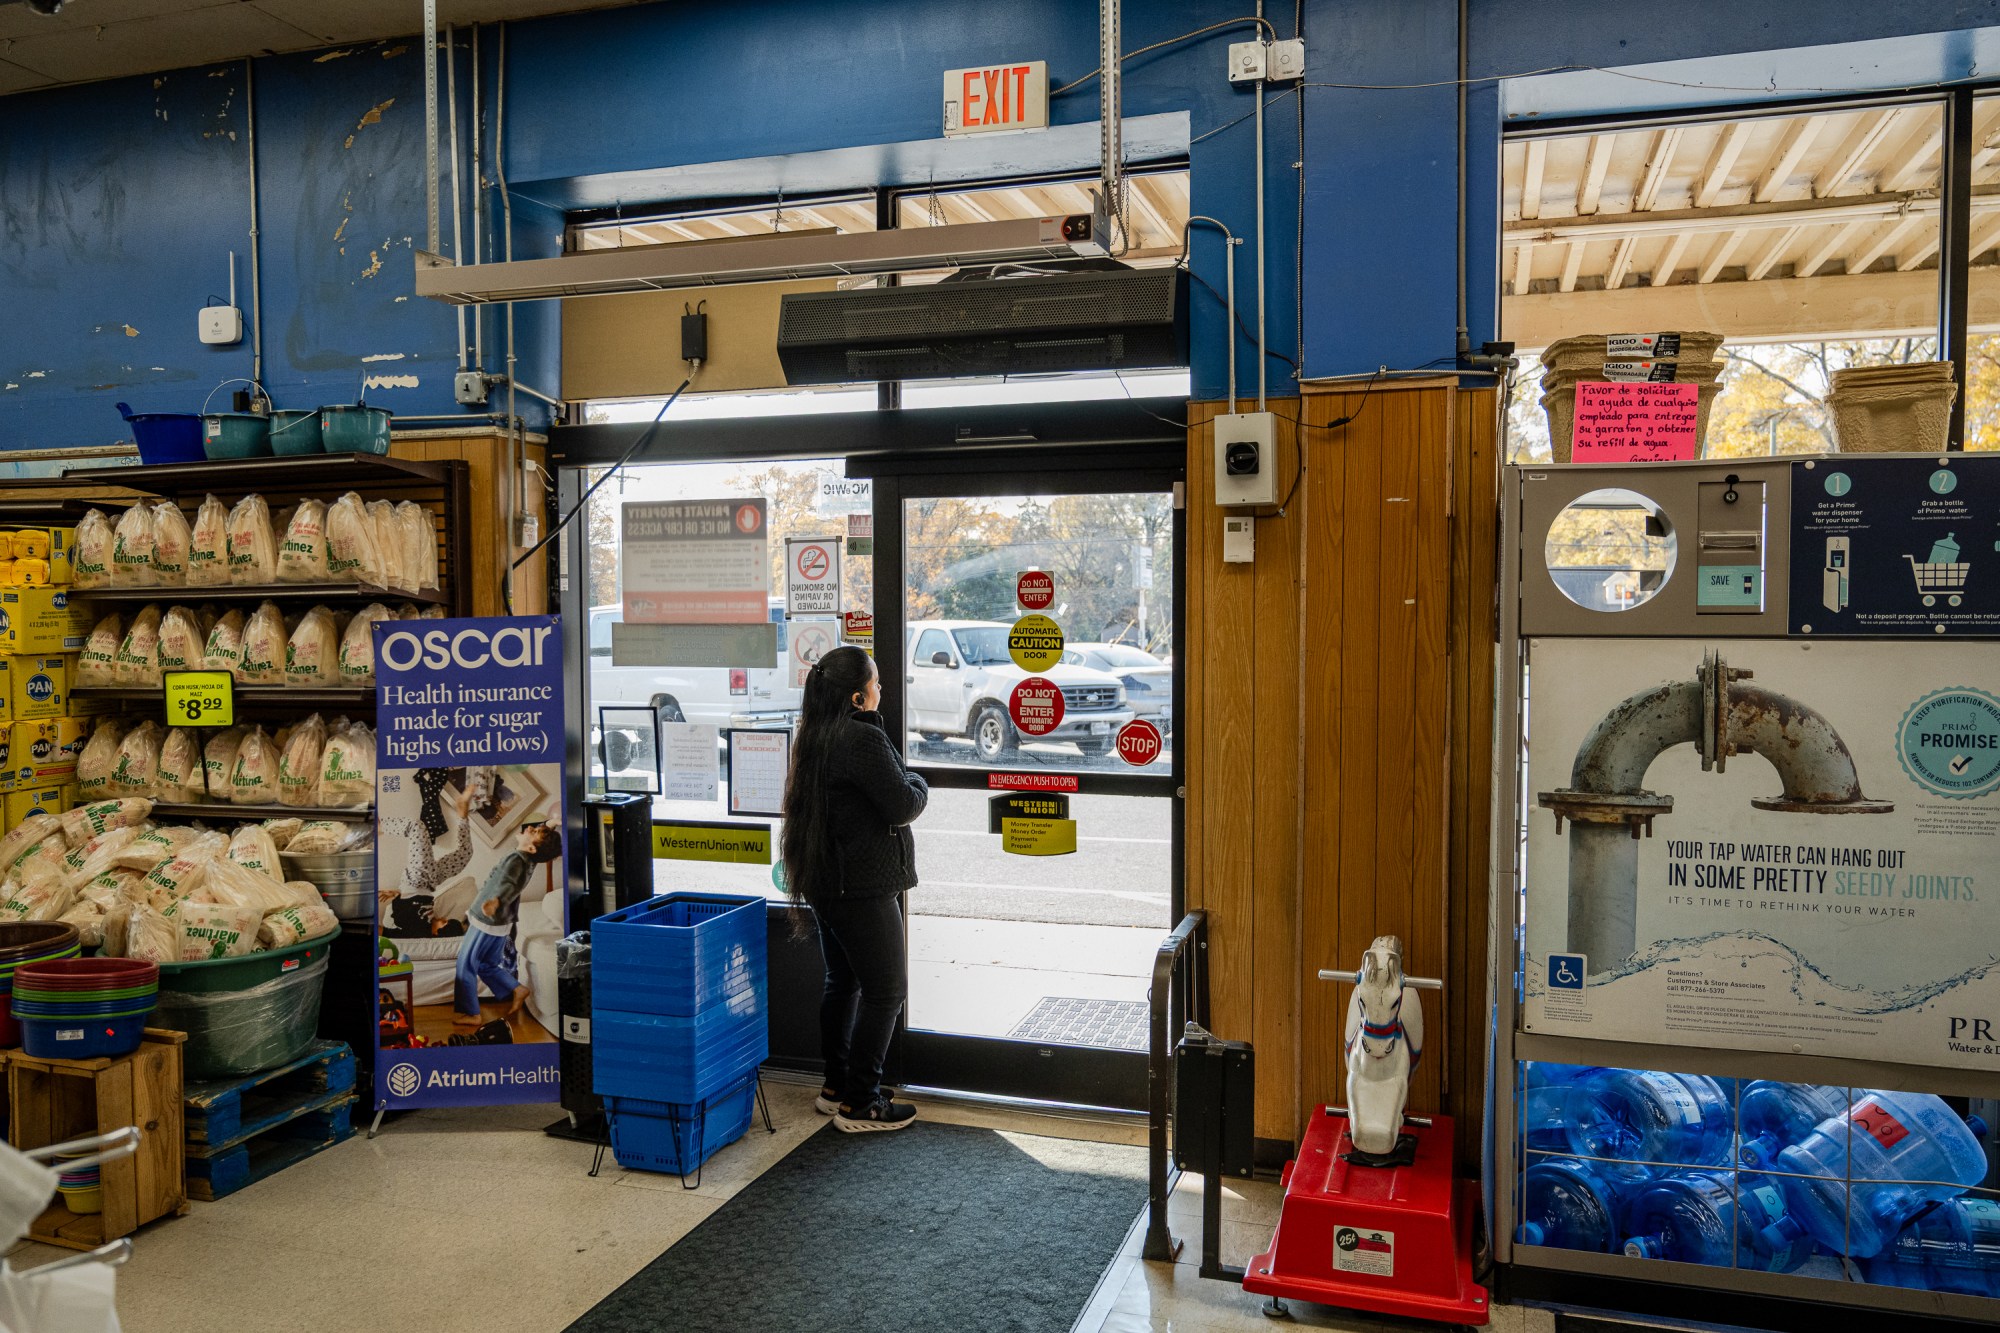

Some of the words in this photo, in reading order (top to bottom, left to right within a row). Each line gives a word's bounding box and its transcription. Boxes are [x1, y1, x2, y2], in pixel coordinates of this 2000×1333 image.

[963, 66, 1030, 127] EXIT
[1582, 385, 1615, 395] Favor
[1619, 385, 1629, 394] de
[1638, 386, 1682, 395] solicitar
[1583, 397, 1592, 406] la
[1599, 397, 1632, 413] ayuda
[1638, 397, 1649, 406] de
[1654, 397, 1697, 411] cualquier
[1580, 411, 1622, 425] empleado
[1628, 413, 1648, 425] para
[1655, 412, 1696, 425] entregar
[1579, 425, 1592, 433] su
[1646, 427, 1653, 437] y
[1658, 424, 1695, 433] obtener
[1578, 439, 1592, 447] su
[1598, 438, 1624, 446] refill
[1629, 438, 1638, 446] de
[1834, 476, 1841, 493] 1
[1939, 473, 1947, 492] 2
[1033, 579, 1049, 587] NOT
[1711, 575, 1730, 585] SAVE
[382, 626, 551, 671] oscar
[1011, 638, 1060, 648] CAUTION
[80, 648, 113, 662] artinez
[27, 682, 53, 694] PAN
[383, 683, 452, 705] Health
[458, 684, 552, 703] insurance
[1018, 689, 1032, 697] DO
[1036, 689, 1056, 698] NOT
[1020, 707, 1054, 716] ENTER
[1912, 707, 1930, 726] 9-STEP
[1932, 697, 1982, 709] PURIFICATION
[394, 709, 449, 731] made
[453, 707, 484, 729] for
[489, 711, 542, 733] sugar
[386, 735, 441, 762] highs
[447, 732, 491, 758] (and
[497, 730, 548, 755] lows)
[1122, 737, 1155, 754] STOP
[1921, 733, 1998, 748] PROMISE
[1911, 753, 1927, 774] REMOVES
[1926, 771, 1935, 779] OR
[1935, 777, 1960, 787] REDUCES
[991, 774, 997, 783] IN
[1000, 775, 1032, 785] EMERGENCY
[1034, 776, 1049, 785] PUSH
[1051, 777, 1059, 786] TO
[1060, 777, 1076, 786] OPEN
[660, 836, 739, 851] WesternUnion
[1667, 840, 1703, 859] YOUR
[1709, 842, 1735, 861] TAP
[1741, 843, 1791, 863] WATER
[1797, 846, 1826, 865] CAN
[1832, 848, 1871, 867] HANG
[1878, 849, 1905, 869] OUT
[1668, 863, 1686, 887] IN
[1695, 864, 1745, 890] SOME
[1753, 867, 1827, 894] PRETTY
[1835, 871, 1896, 897] SEEDY
[1902, 874, 1978, 901] JOINTS.
[1669, 896, 1693, 905] IT'S
[1700, 898, 1731, 907] TIME
[1738, 900, 1753, 908] TO
[1760, 901, 1819, 912] RETHINK
[1827, 905, 1861, 914] YOUR
[1869, 907, 1915, 918] WATER
[186, 927, 240, 944] Martinez
[1681, 986, 1725, 994] 877-266-5370
[1948, 1017, 1997, 1041] PR
[1948, 1042, 1982, 1053] Water
[1984, 1045, 1992, 1054] &
[427, 1069, 496, 1088] Atrium
[500, 1066, 561, 1085] Health
[1340, 1233, 1356, 1245] 25¢
